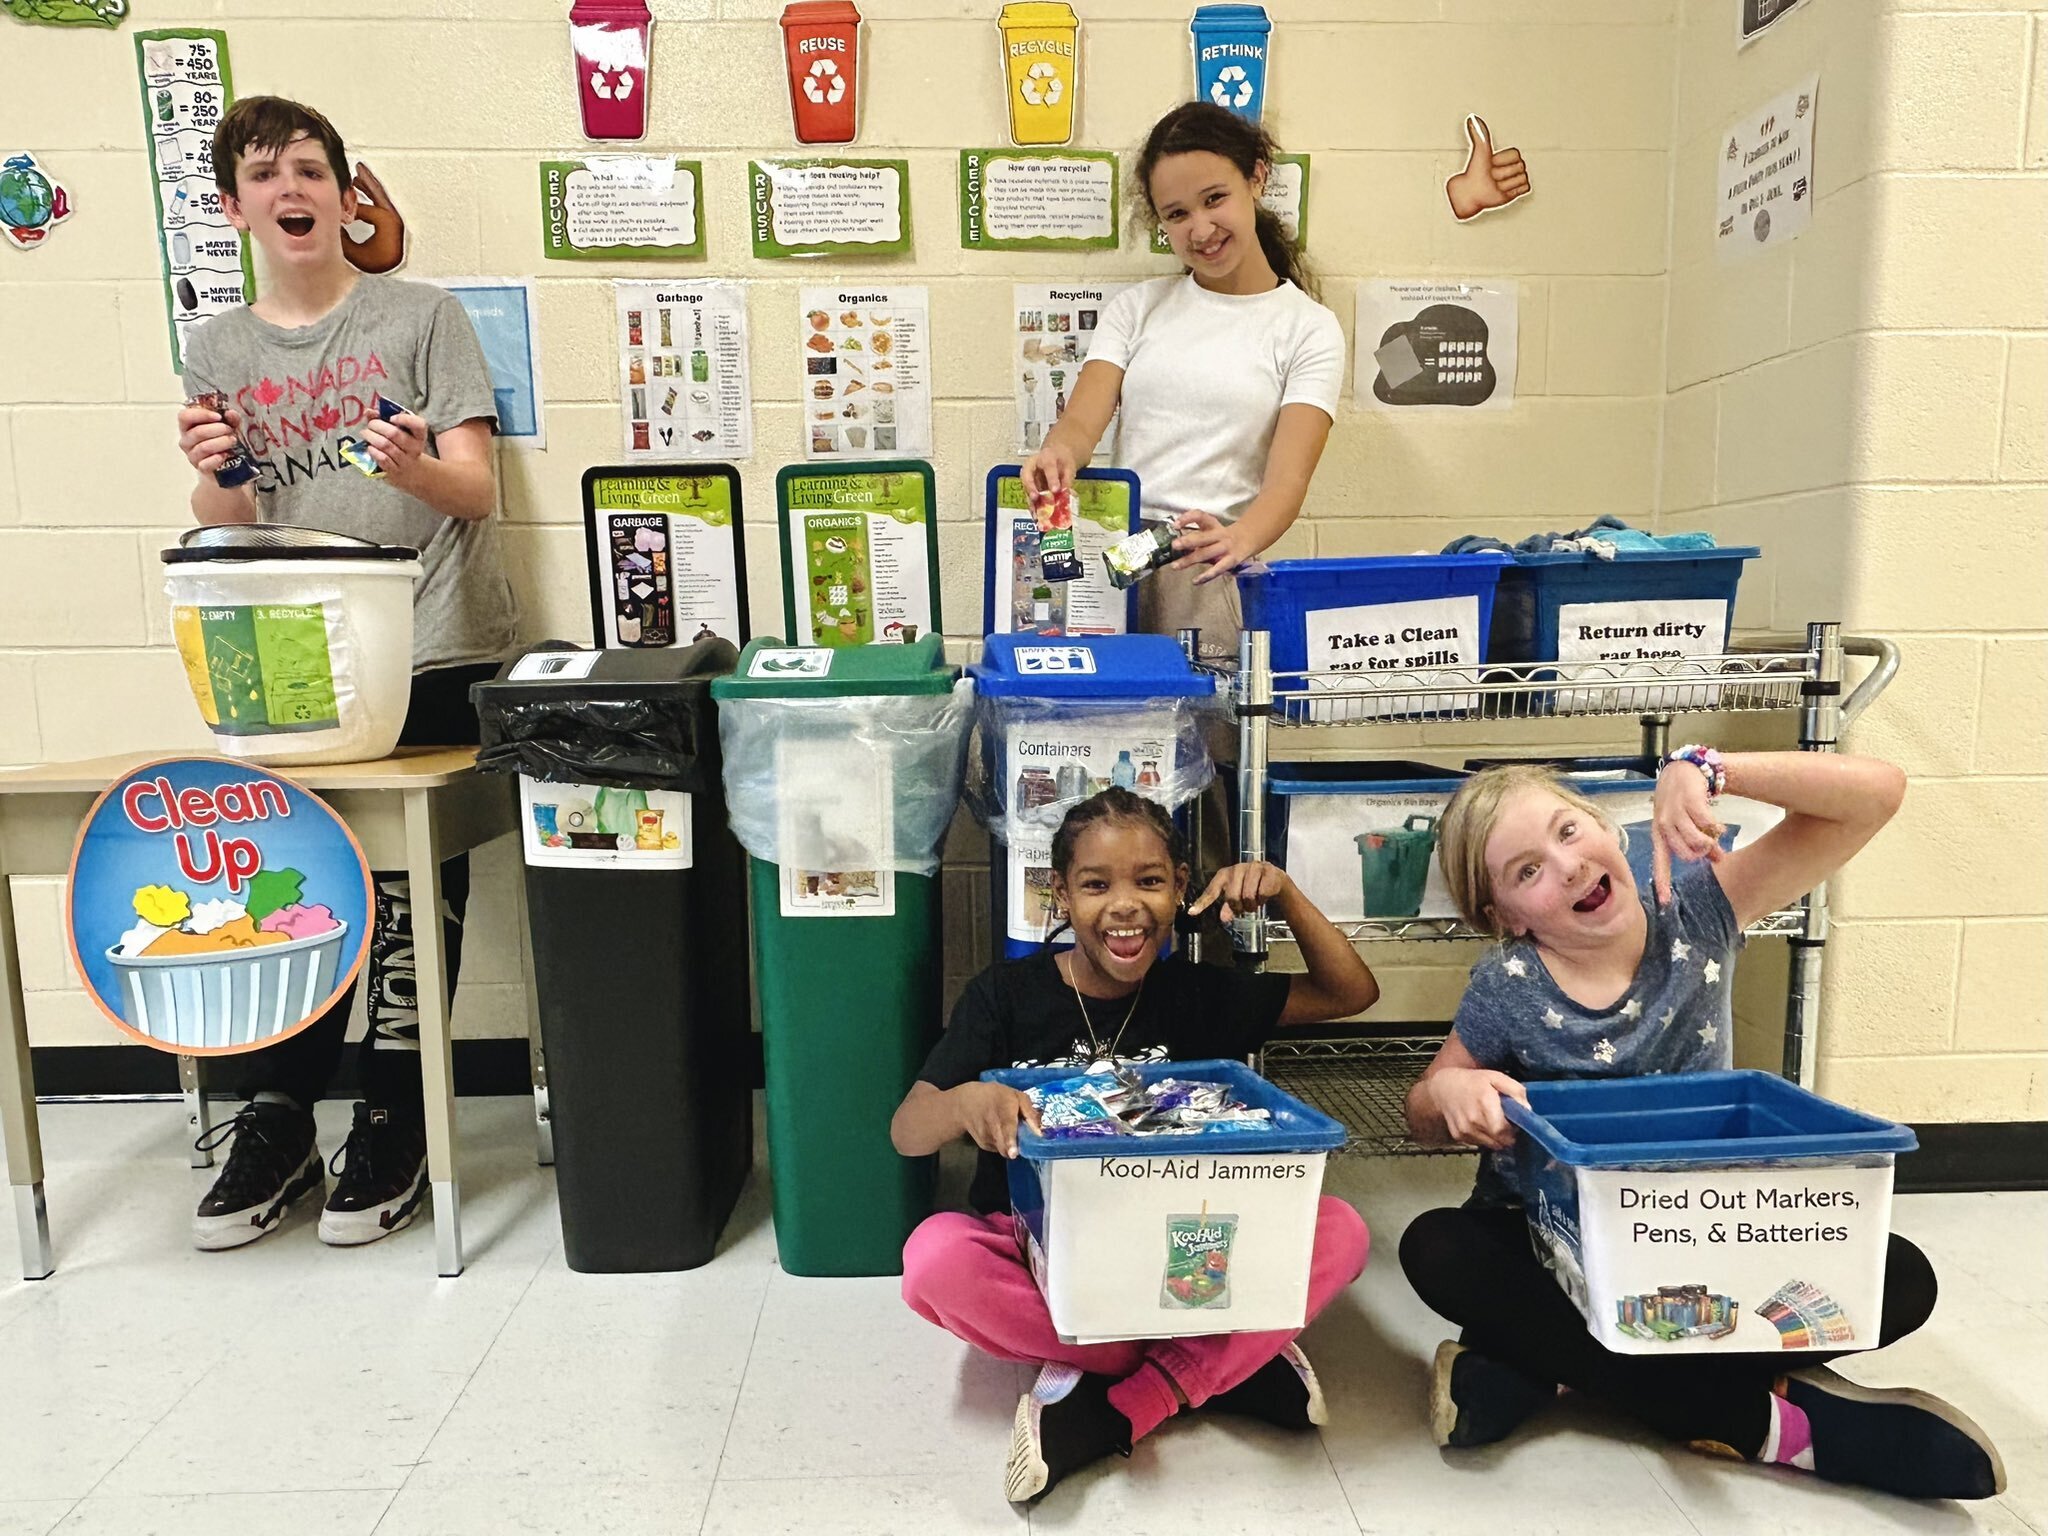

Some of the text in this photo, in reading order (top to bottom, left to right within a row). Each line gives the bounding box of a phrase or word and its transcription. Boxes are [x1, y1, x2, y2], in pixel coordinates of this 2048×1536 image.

[189, 43, 211, 56] 75-
[800, 37, 846, 54] REUSE
[1009, 40, 1072, 58] RECYCLE
[1202, 43, 1263, 61] RETHINK
[187, 58, 213, 70] 450
[185, 72, 217, 80] YEARS
[194, 92, 218, 103] 80-
[192, 106, 218, 117] 250
[1008, 164, 1024, 172] How
[1043, 165, 1056, 173] you
[967, 155, 981, 241] RECYCLE
[549, 170, 562, 247] REDUCE
[755, 173, 768, 242] REUSE
[205, 241, 237, 249] MAYBE
[207, 249, 238, 257] NEVER
[210, 287, 241, 295] MAYBE
[656, 293, 704, 304] Garbage
[838, 293, 888, 304] Organics
[1050, 290, 1102, 301] Recycling
[600, 477, 670, 494] Learning &
[792, 476, 863, 493] Learning &
[600, 490, 680, 507] Living Green
[792, 489, 873, 506] Living Green
[613, 517, 663, 527] GARBAGE
[808, 516, 862, 528] ORGANICS
[1014, 522, 1038, 530] RECY
[208, 611, 236, 621] EMPTY
[1328, 627, 1459, 650] Take a Clean
[1578, 622, 1707, 640] Return dirty
[1368, 657, 1399, 670] for
[1404, 650, 1460, 669] spills
[1018, 740, 1091, 757] Containers
[123, 777, 291, 832] Clean
[174, 829, 261, 894] Up
[1100, 1157, 1306, 1180] Kool-Aid Jammers
[1620, 1187, 1860, 1210] Dried Out Markers,
[1633, 1222, 1848, 1246] Pens, & Batteries
